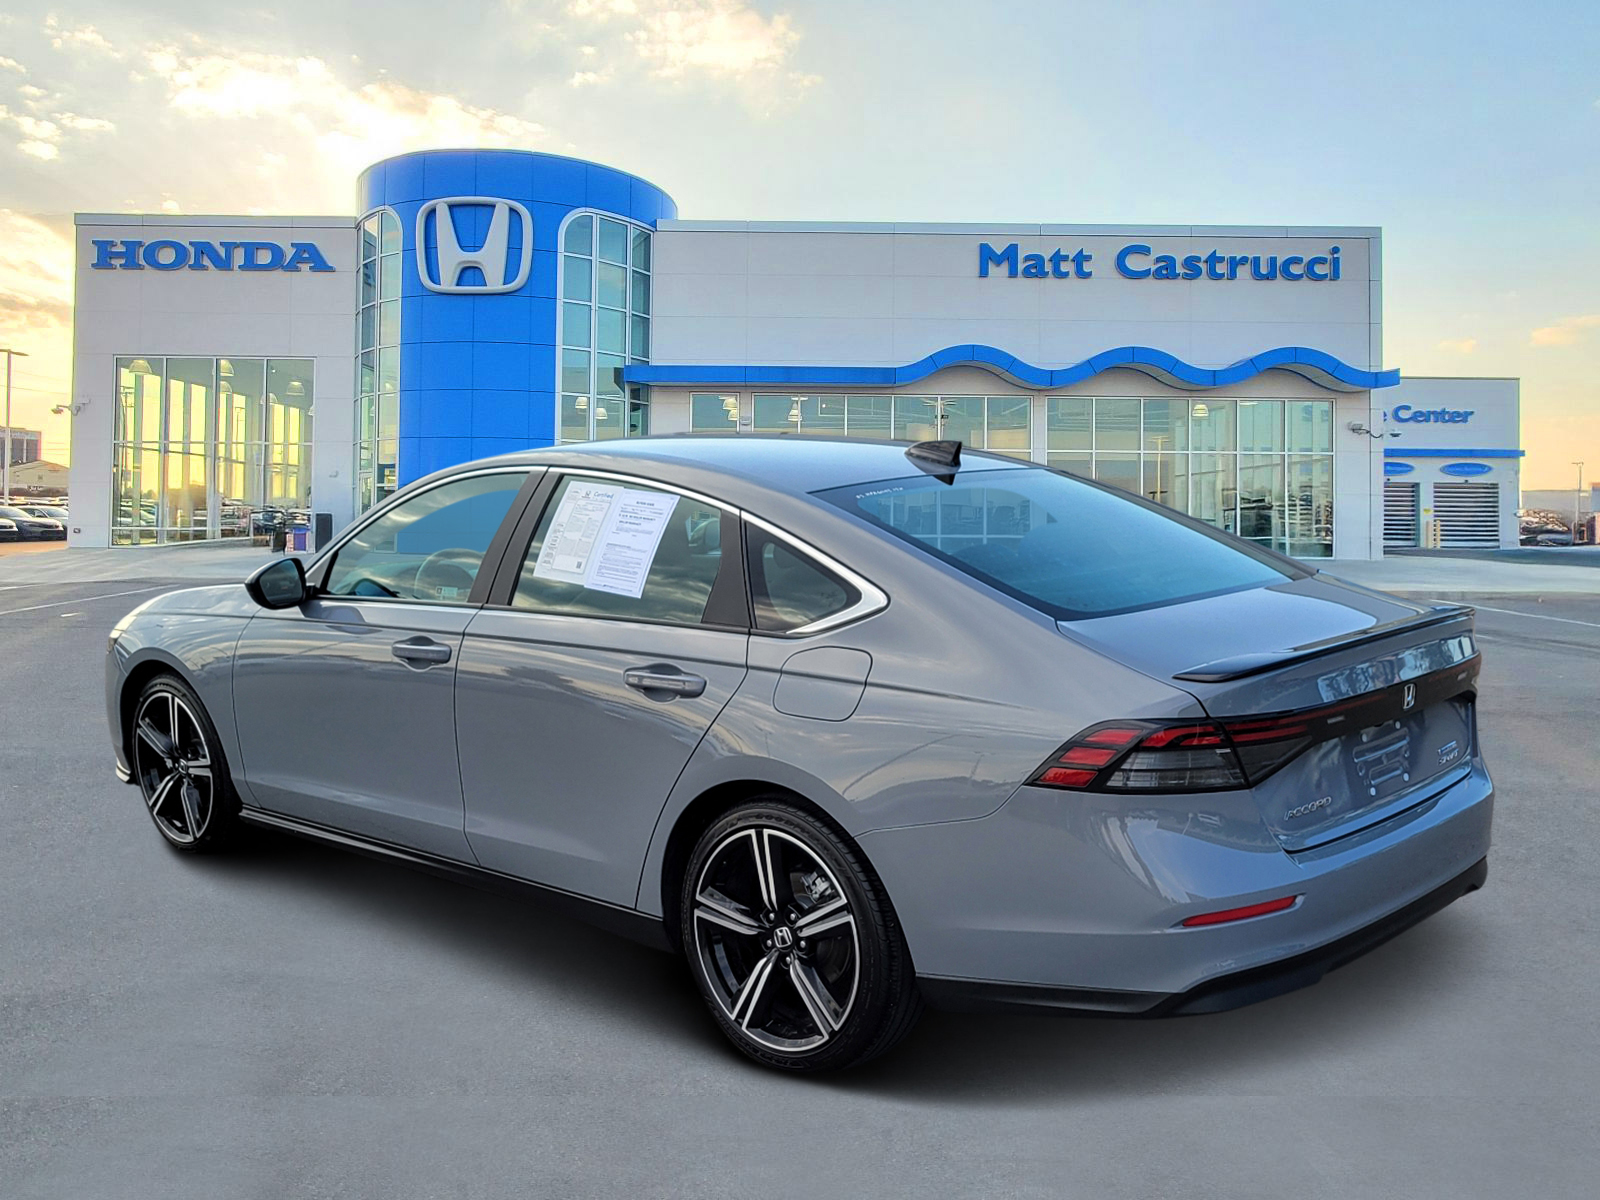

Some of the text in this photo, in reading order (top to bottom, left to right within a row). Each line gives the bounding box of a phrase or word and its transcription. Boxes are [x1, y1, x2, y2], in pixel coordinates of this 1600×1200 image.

[91, 239, 337, 272] HONDA
[979, 242, 1342, 281] Matt Castrucci
[1392, 405, 1475, 423] Center
[1284, 796, 1332, 821] ACCORD
